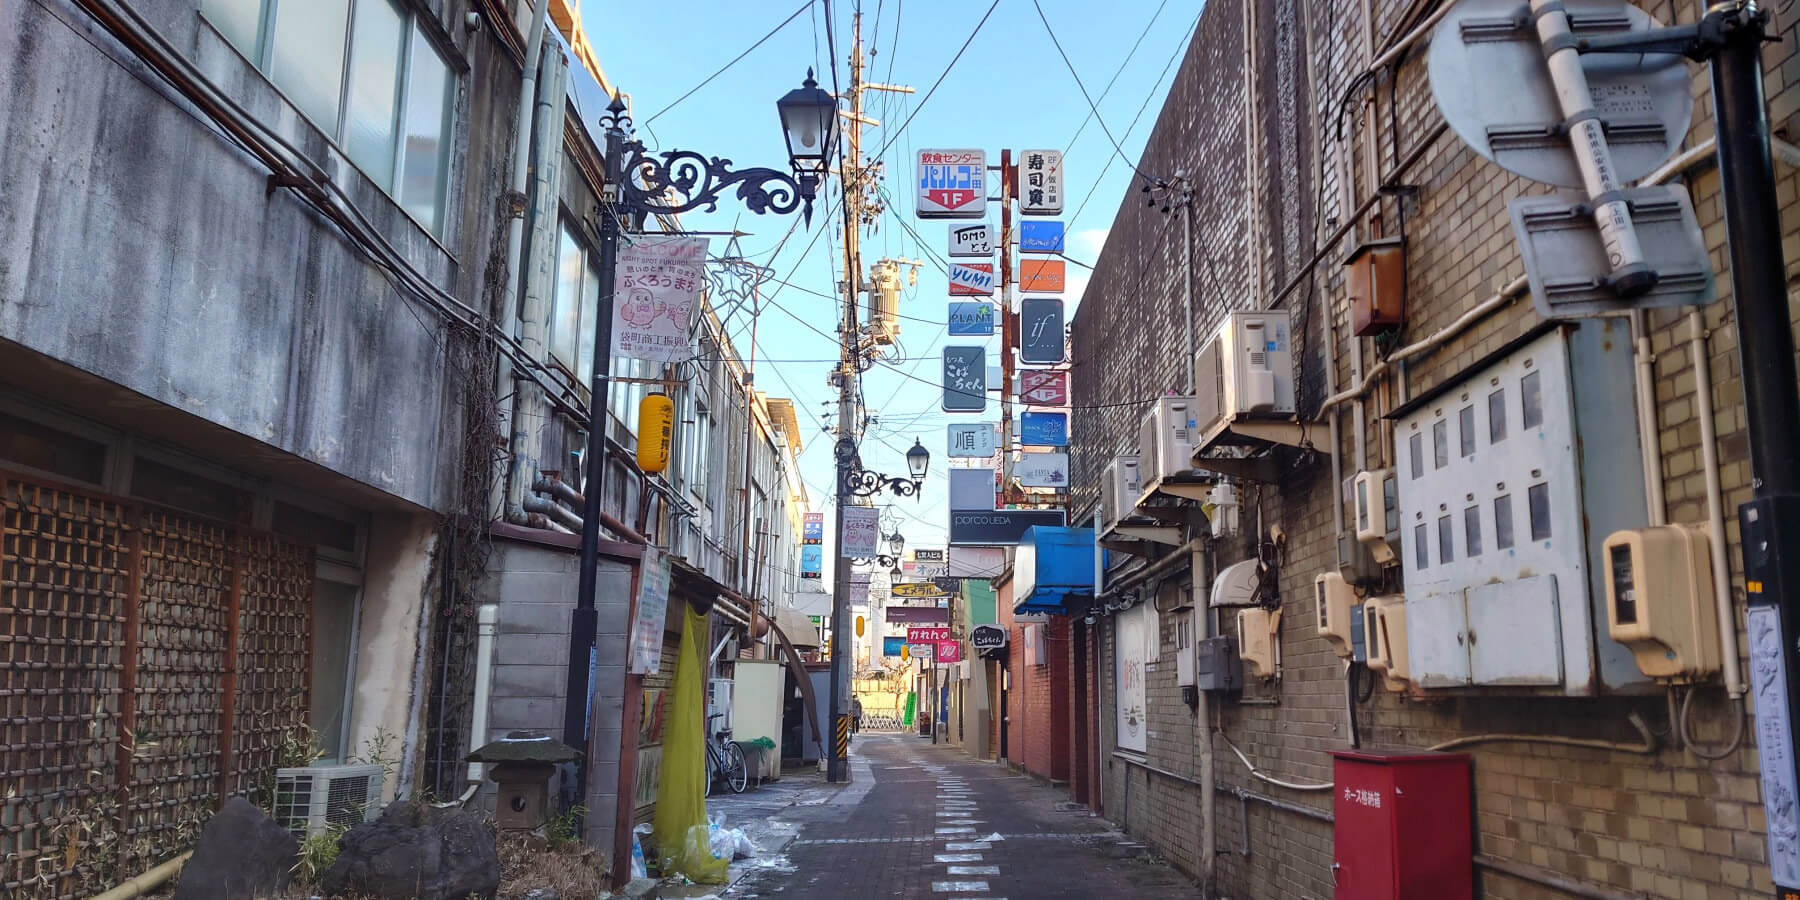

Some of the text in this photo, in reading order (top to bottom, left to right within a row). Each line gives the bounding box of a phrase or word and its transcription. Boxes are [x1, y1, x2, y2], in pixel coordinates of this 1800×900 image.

[921, 152, 981, 163] 飲食センター
[921, 166, 970, 189] パルコ
[972, 166, 982, 189] 上田
[942, 192, 963, 205] 1F
[971, 242, 991, 252] とも
[623, 274, 696, 293] ふくろうまち
[952, 267, 992, 288] YUMI
[952, 313, 992, 323] PLANT
[955, 377, 983, 390] ちゃん
[955, 431, 976, 450] 順
[1344, 787, 1381, 808] ホース格納箱
